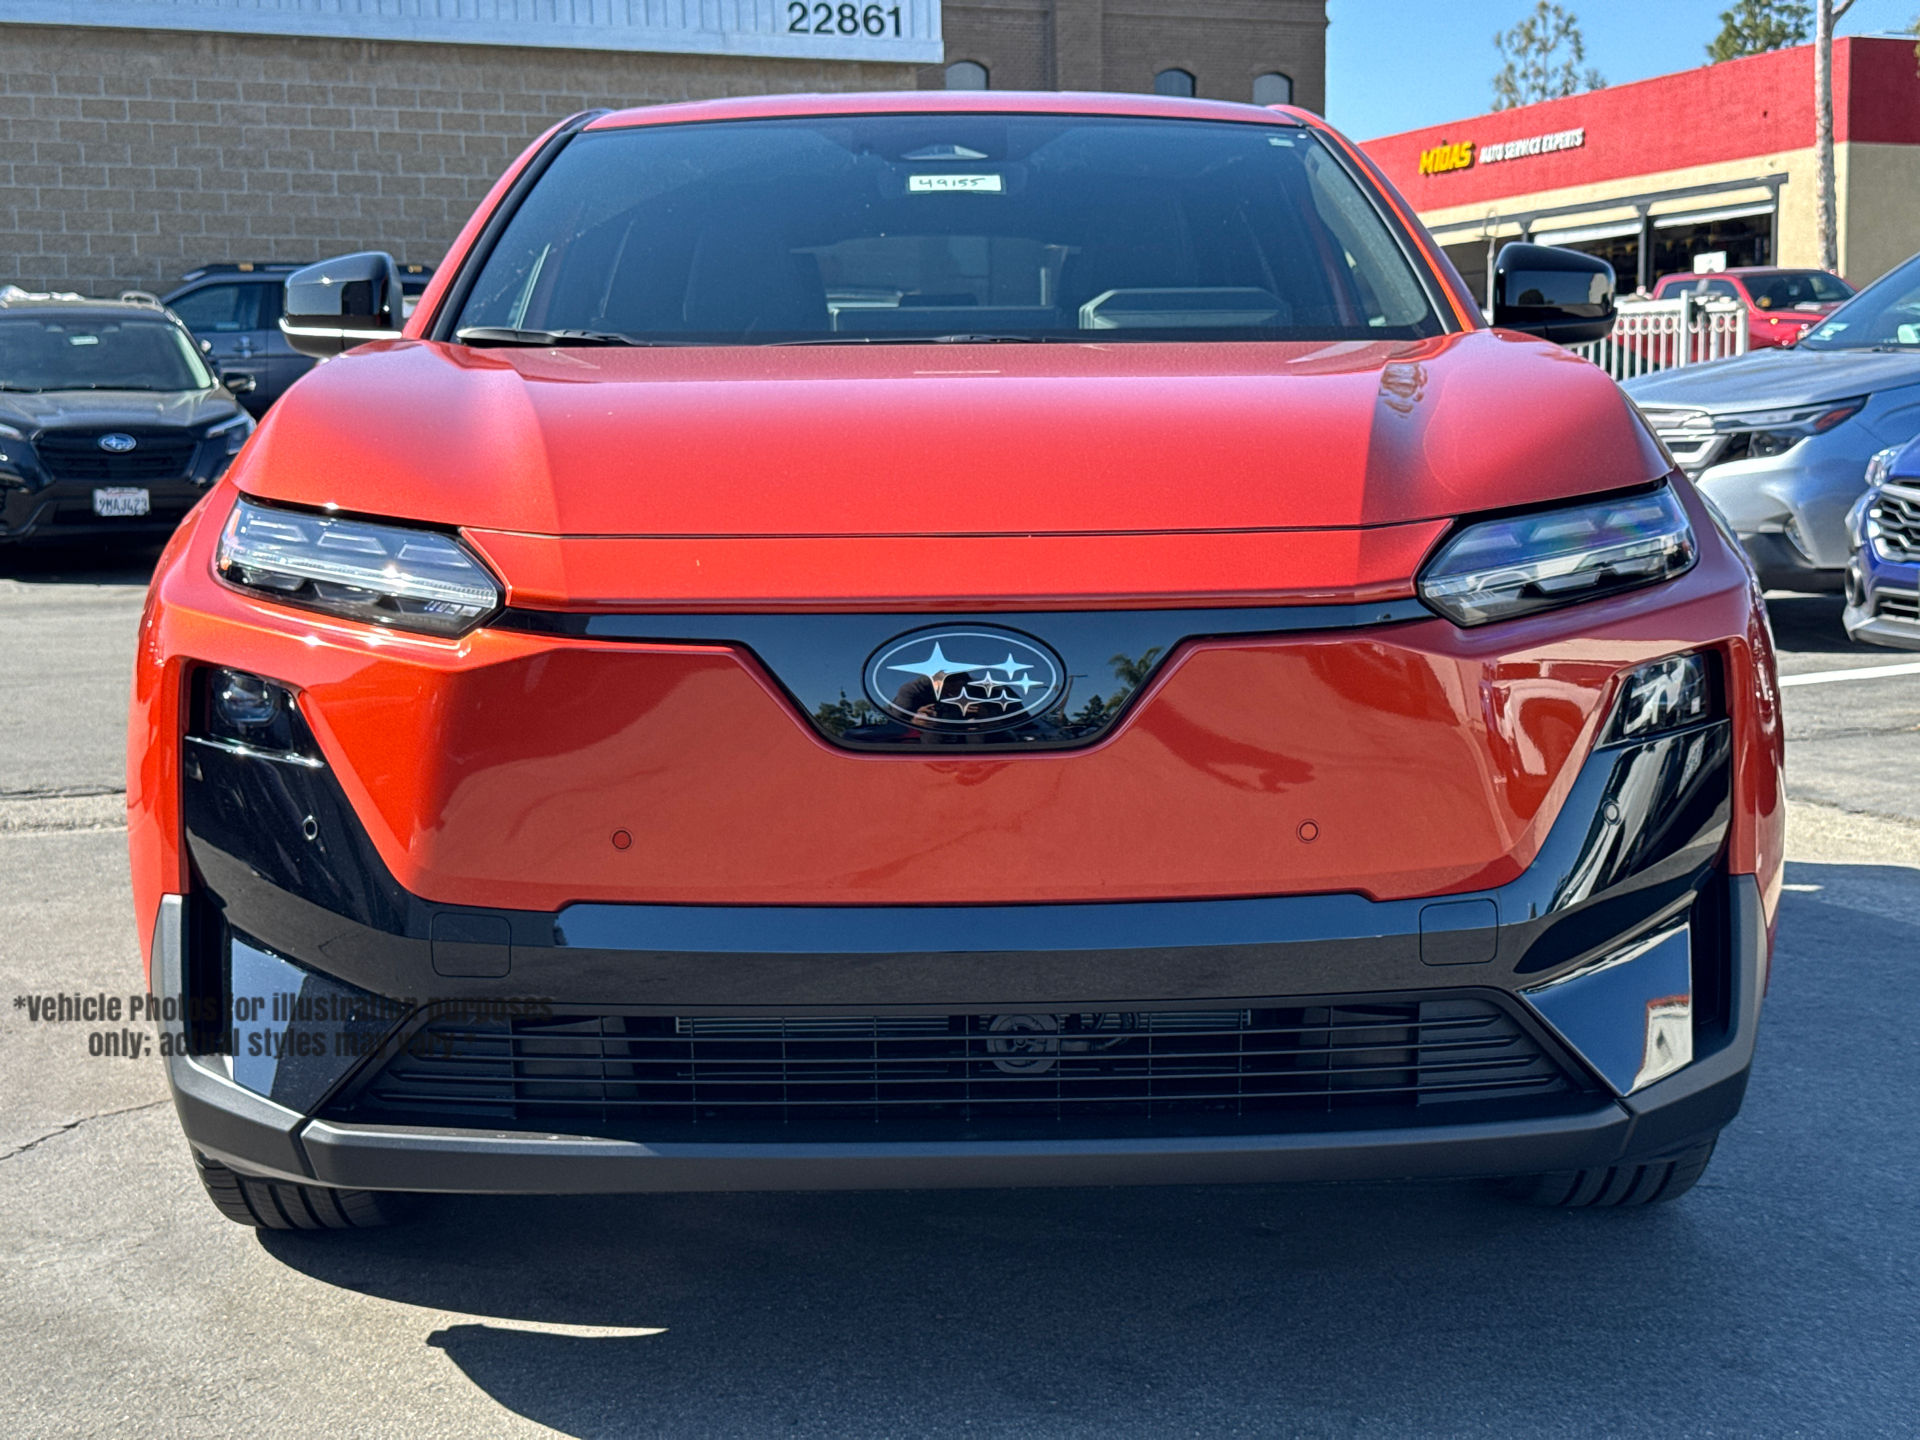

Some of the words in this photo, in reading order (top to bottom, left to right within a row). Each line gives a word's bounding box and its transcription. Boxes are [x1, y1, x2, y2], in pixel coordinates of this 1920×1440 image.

[788, 2, 901, 37] 22861
[1418, 141, 1473, 174] MIDAS
[1479, 144, 1504, 164] AUTO
[1504, 136, 1541, 160] SERVICE
[1541, 127, 1584, 153] EXPERTS
[919, 177, 986, 188] 49155
